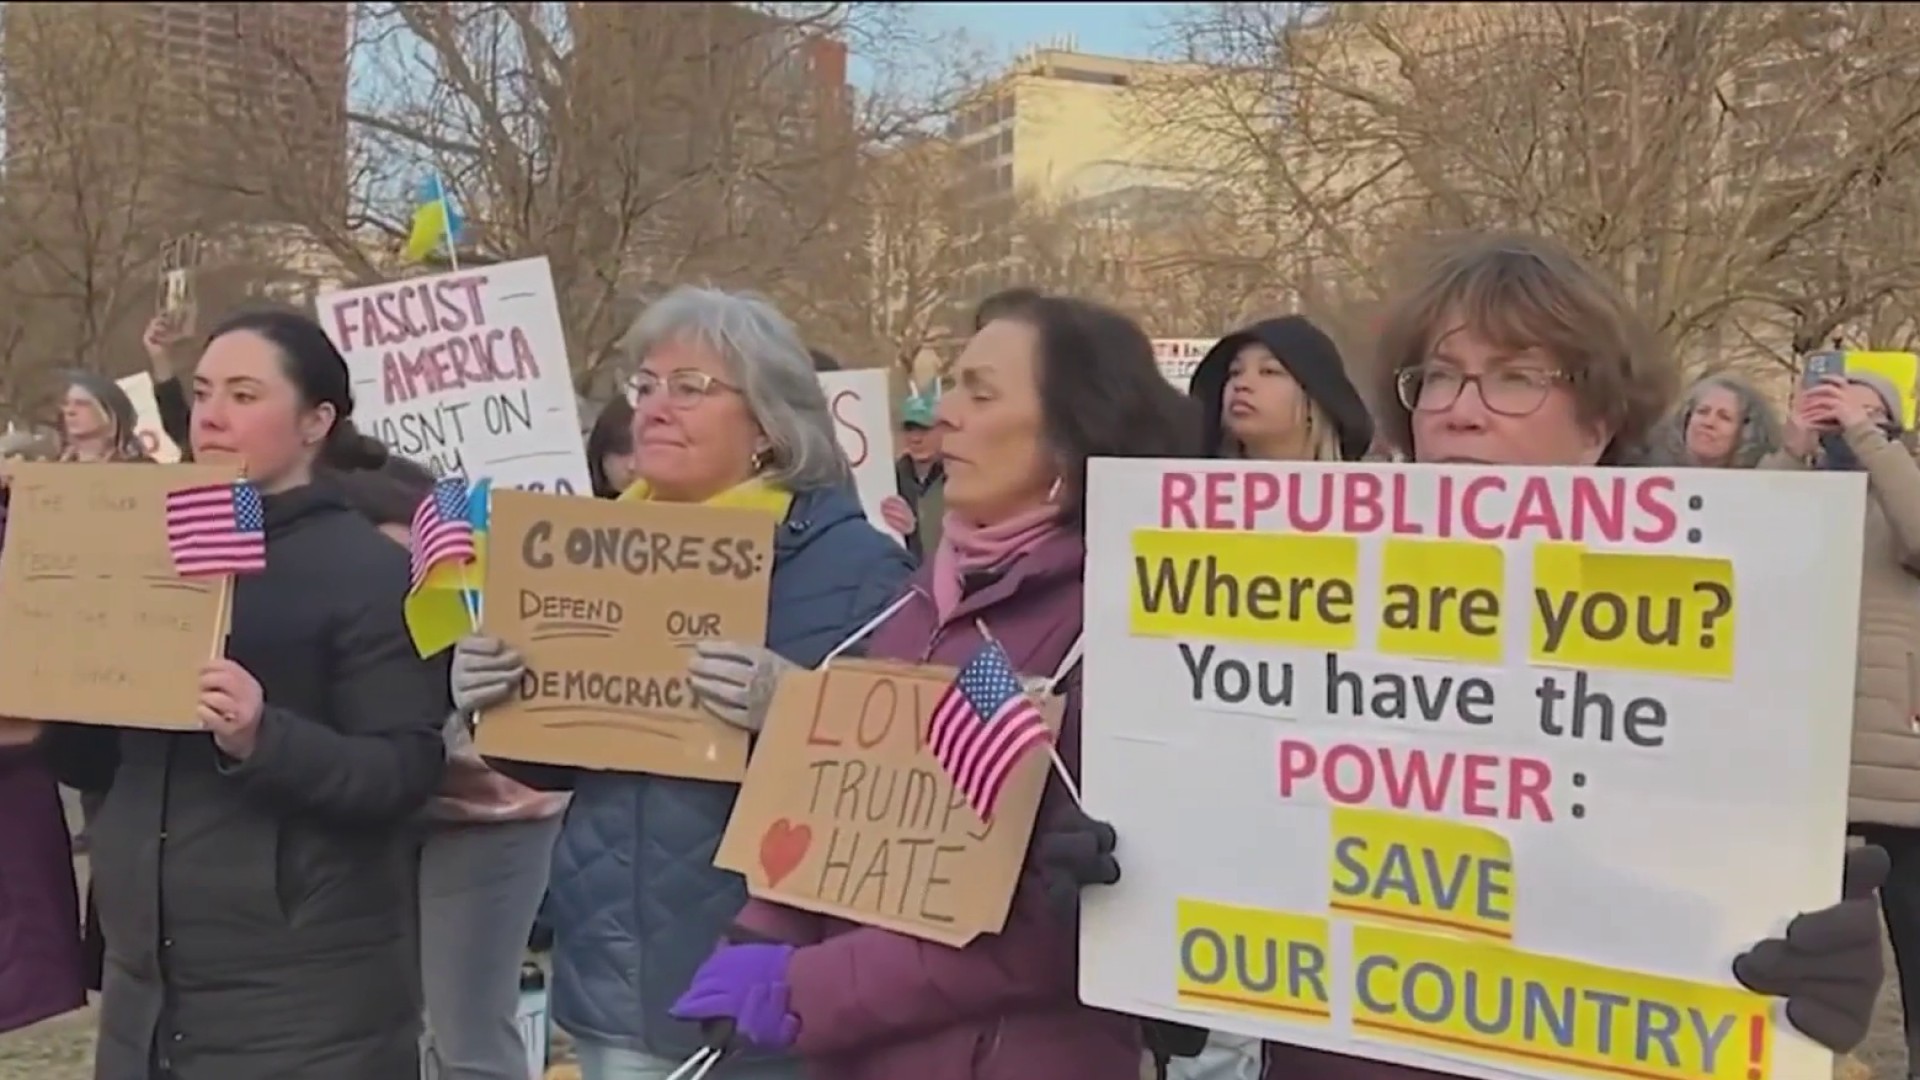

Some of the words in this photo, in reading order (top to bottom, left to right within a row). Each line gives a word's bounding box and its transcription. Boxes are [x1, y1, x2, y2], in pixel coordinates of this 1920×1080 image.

[332, 276, 488, 352] FASCIST
[382, 326, 541, 405] AMERICA
[484, 388, 532, 436] ON
[1161, 471, 1703, 544] REPUBLICANS:
[522, 520, 763, 580] CONGRESS:
[520, 588, 623, 624] DEFEND
[666, 611, 721, 636] OUR
[1135, 555, 1354, 624] Where
[1382, 583, 1500, 636] are
[1535, 581, 1733, 653] you?
[1178, 643, 1294, 707] You
[1326, 652, 1495, 725] have
[1535, 671, 1667, 747] the
[816, 827, 966, 922] HATE
[1332, 836, 1512, 921] SAVE
[1180, 927, 1329, 1002] OUR
[1356, 954, 1766, 1080] COUNTRY!
